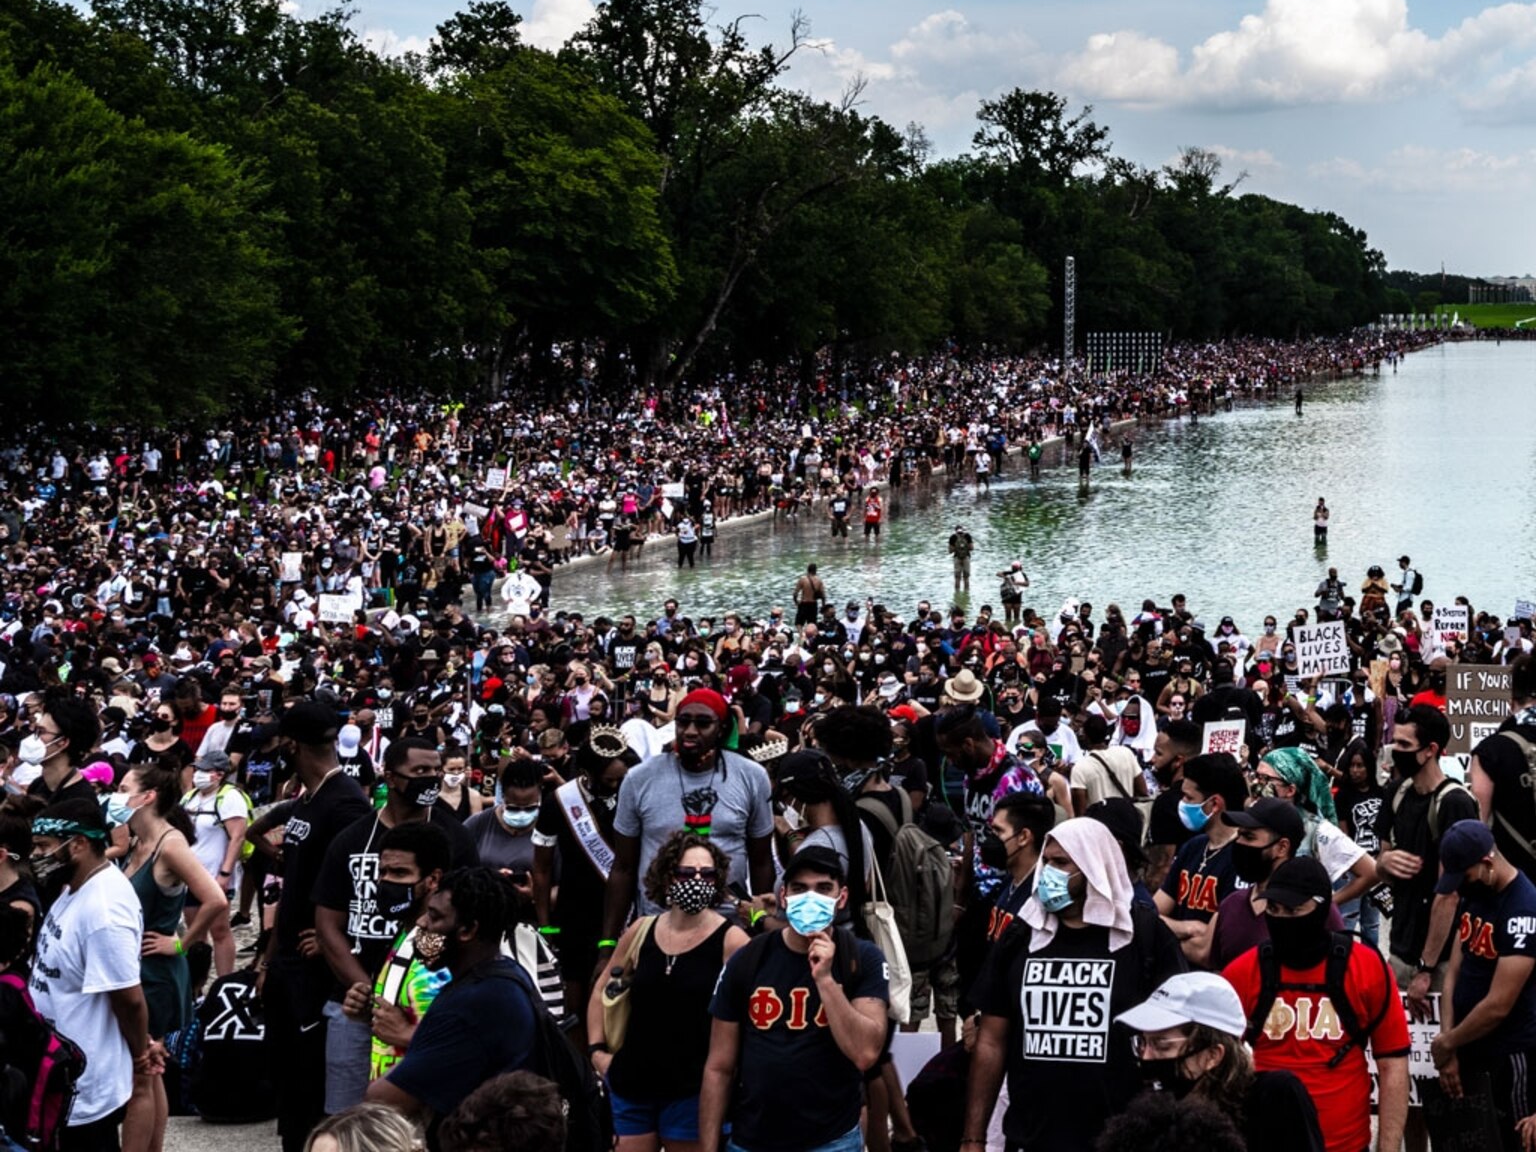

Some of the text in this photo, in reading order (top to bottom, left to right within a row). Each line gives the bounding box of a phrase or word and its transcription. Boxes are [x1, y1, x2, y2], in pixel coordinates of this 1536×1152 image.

[1299, 626, 1342, 643] BLACK
[1301, 640, 1341, 656] LIVES
[1302, 655, 1348, 674] MATTER
[1457, 671, 1512, 690] IF YOU'R
[1448, 698, 1512, 716] MARCHIN
[1452, 723, 1464, 739] U
[348, 856, 380, 881] GET
[348, 913, 399, 936] NECK
[1507, 916, 1536, 935] GMU
[1513, 933, 1527, 948] Z
[1026, 962, 1110, 986] BLACK
[1025, 990, 1105, 1028] LIVES
[1025, 1032, 1103, 1057] MATTER
